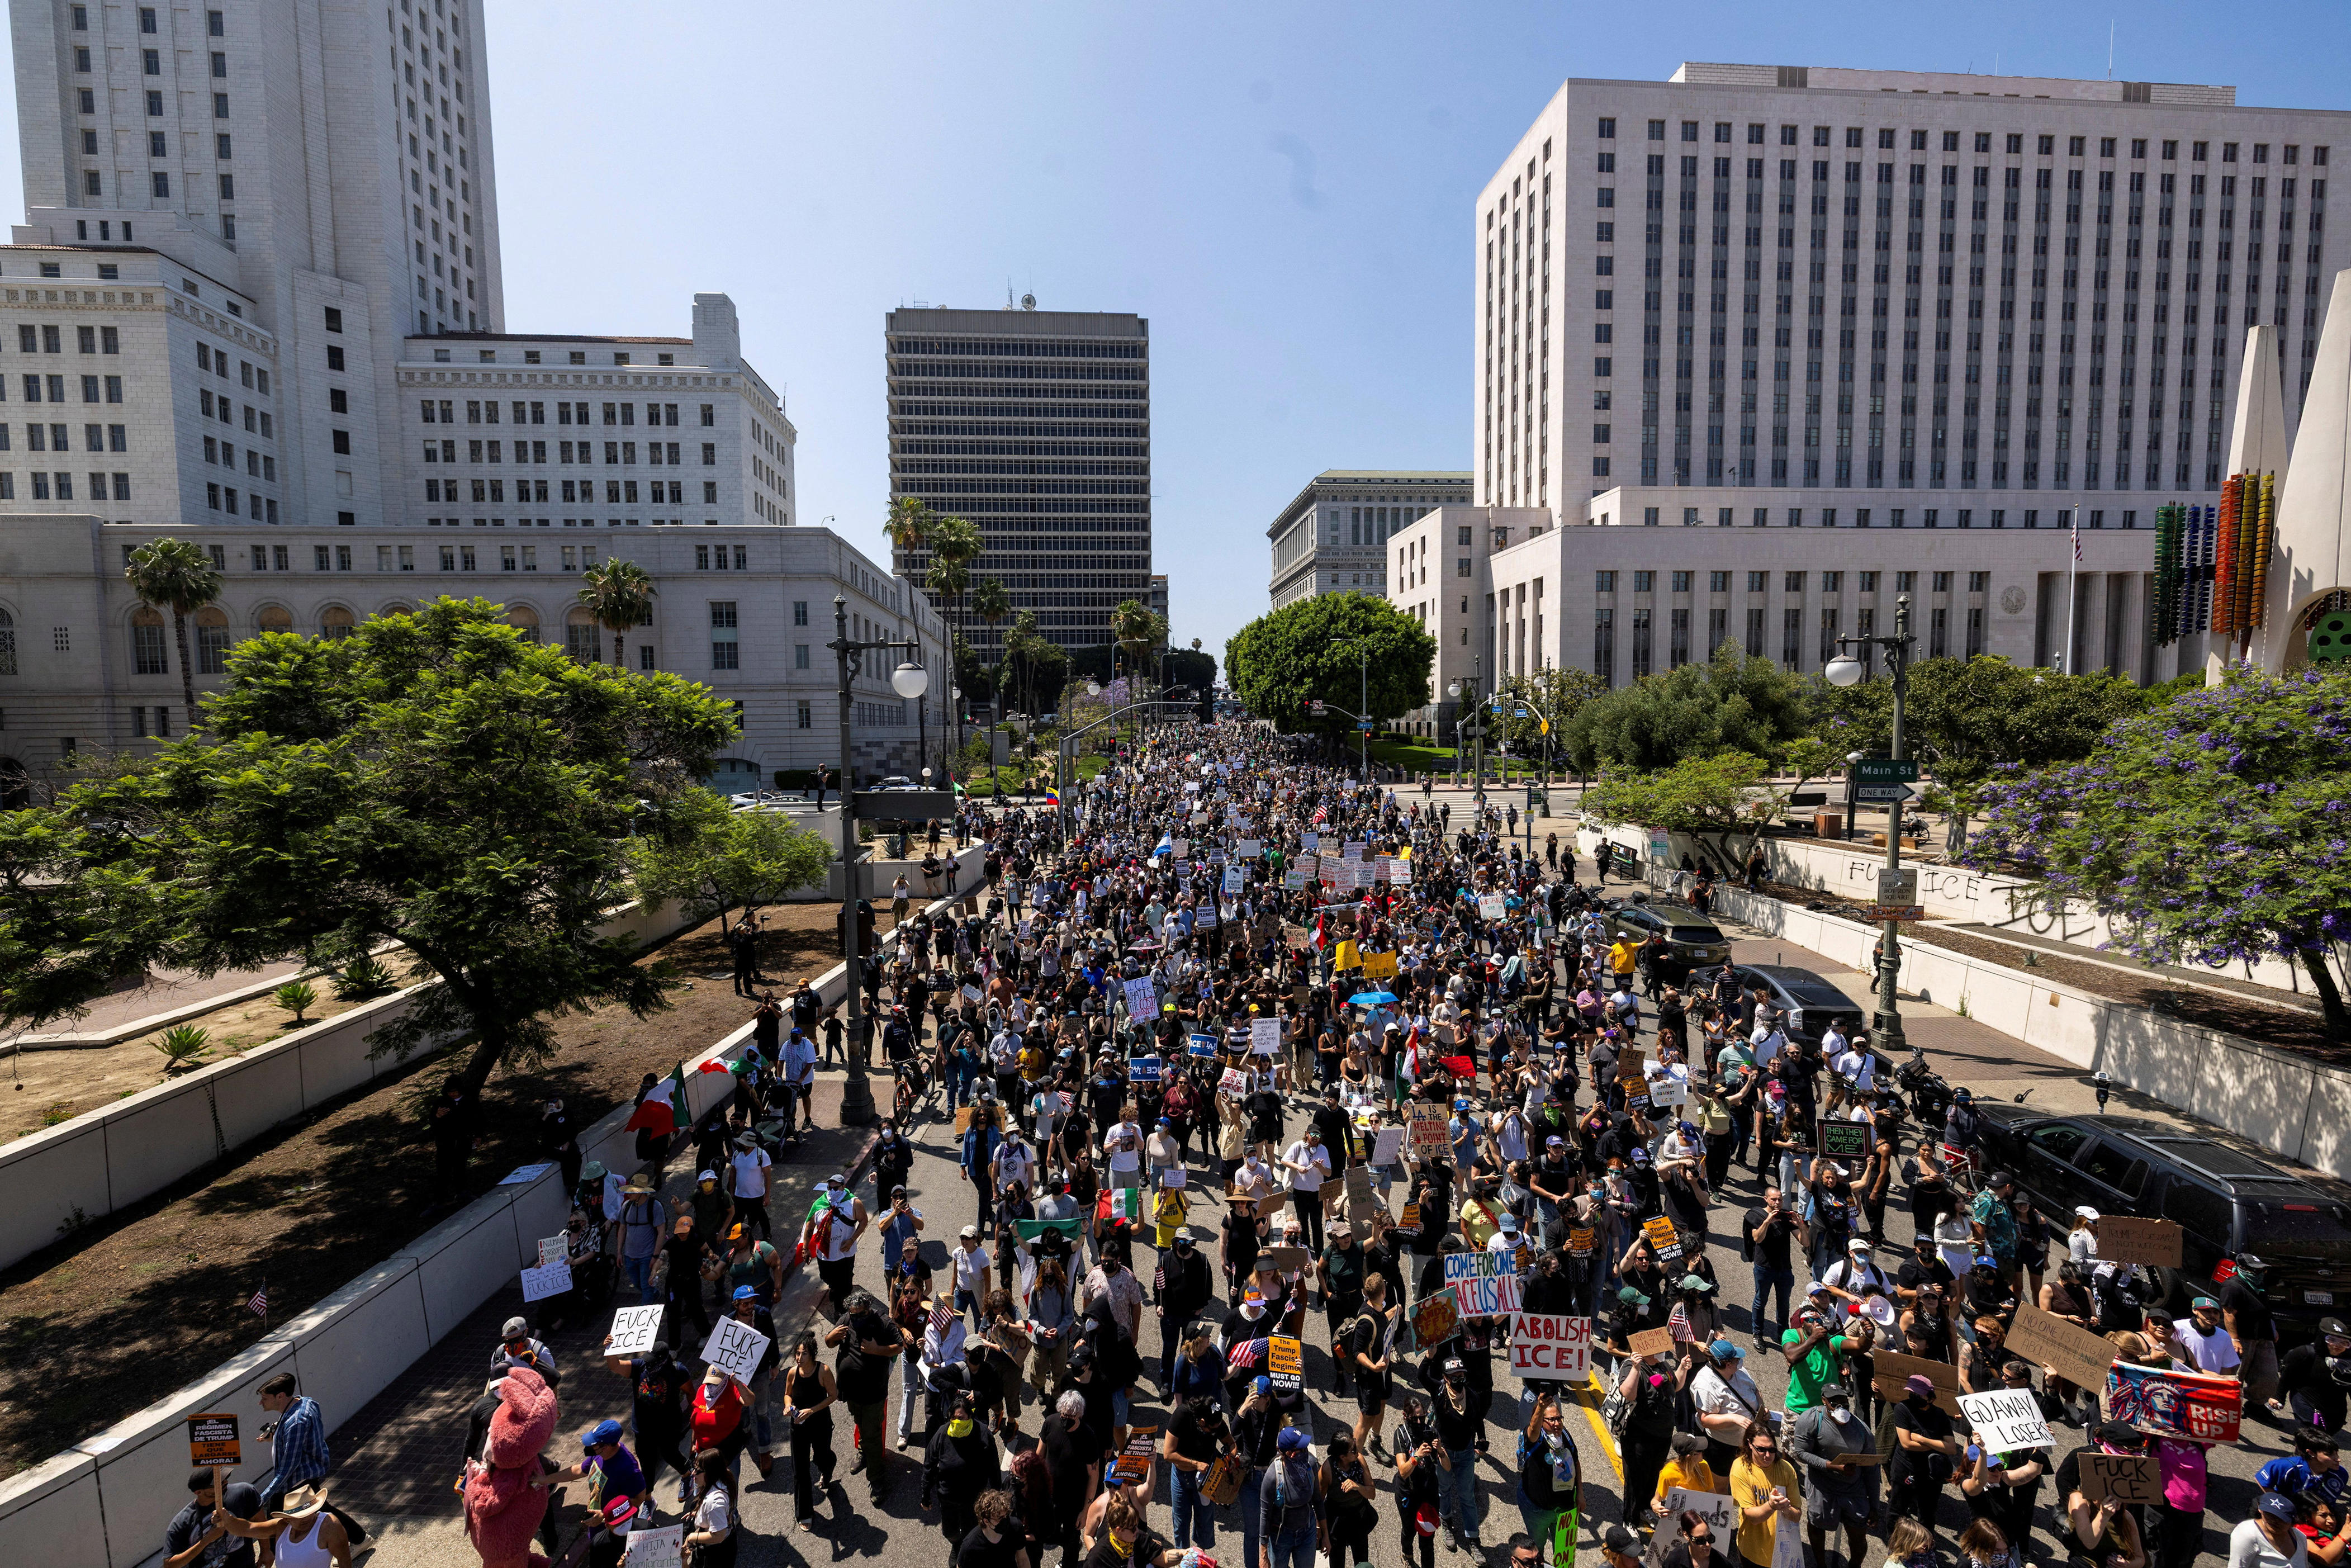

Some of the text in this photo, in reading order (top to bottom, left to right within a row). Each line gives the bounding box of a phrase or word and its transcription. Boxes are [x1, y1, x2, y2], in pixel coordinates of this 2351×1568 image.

[1862, 766, 1912, 775] Main St
[1181, 878, 1189, 889] ICE
[1850, 861, 1980, 901] FU ICE
[1126, 977, 1148, 992] ICE
[1125, 989, 1142, 1002] WHAT
[1128, 996, 1156, 1012] THE COST?
[1128, 1006, 1156, 1019] HUMANITY
[1625, 1051, 1639, 1060] ICE
[1411, 1106, 1426, 1121] LA
[1428, 1105, 1437, 1114] IS
[1413, 1120, 1446, 1131] MELTING
[1826, 1126, 1863, 1136] THEN THEY
[1423, 1133, 1447, 1144] POINT
[1826, 1135, 1848, 1144] CAME
[1421, 1144, 1449, 1155] OF ICE
[1650, 1224, 1669, 1233] Trump
[1650, 1229, 1674, 1240] Fascist
[539, 1236, 567, 1249] INHUMANE
[2116, 1240, 2134, 1248] NOT
[2137, 1242, 2176, 1252] WELCOME
[540, 1245, 565, 1258] CORRUPT
[1656, 1246, 1671, 1255] MUST
[1661, 1248, 1683, 1261] NOW!!!
[1445, 1249, 1517, 1278] COME FOR ONE
[524, 1271, 535, 1280] The
[527, 1273, 572, 1297] FUCK ICE!
[1497, 1275, 1522, 1313] ALL
[615, 1308, 660, 1330] FUCK
[1514, 1314, 1591, 1343] ABOLISH
[1636, 1329, 1664, 1342] GO HOME
[612, 1329, 648, 1349] ICE
[719, 1323, 762, 1359] FUCK
[1636, 1336, 1670, 1353] NAZIS
[2022, 1313, 2108, 1362] NO ONE IS ILLEGAL
[1274, 1344, 1296, 1354] Trump
[2036, 1330, 2072, 1356] STOLEN
[2073, 1350, 2098, 1367] LAND
[712, 1347, 747, 1375] ICE
[1271, 1352, 1298, 1362] Fascist
[1515, 1344, 1584, 1371] ICE!
[2020, 1338, 2098, 1382] ABOLISH ICE
[1271, 1361, 1299, 1371] Regime
[1881, 1361, 1896, 1370] all
[1272, 1379, 1300, 1389] NOW!!!
[1963, 1396, 2036, 1424] GO AWAY
[2189, 1403, 2238, 1424] RISE
[1997, 1421, 2054, 1445] LOSERS
[2192, 1422, 2224, 1437] UP
[1208, 1470, 1216, 1482] The
[2093, 1456, 2150, 1482] FUCK
[1208, 1467, 1223, 1491] Trump
[2103, 1477, 2149, 1500] ICE
[1557, 1513, 1572, 1532] NO
[627, 1527, 681, 1547] Orgullosamente
[643, 1538, 666, 1552] HIJA
[1553, 1552, 1568, 1566] ON
